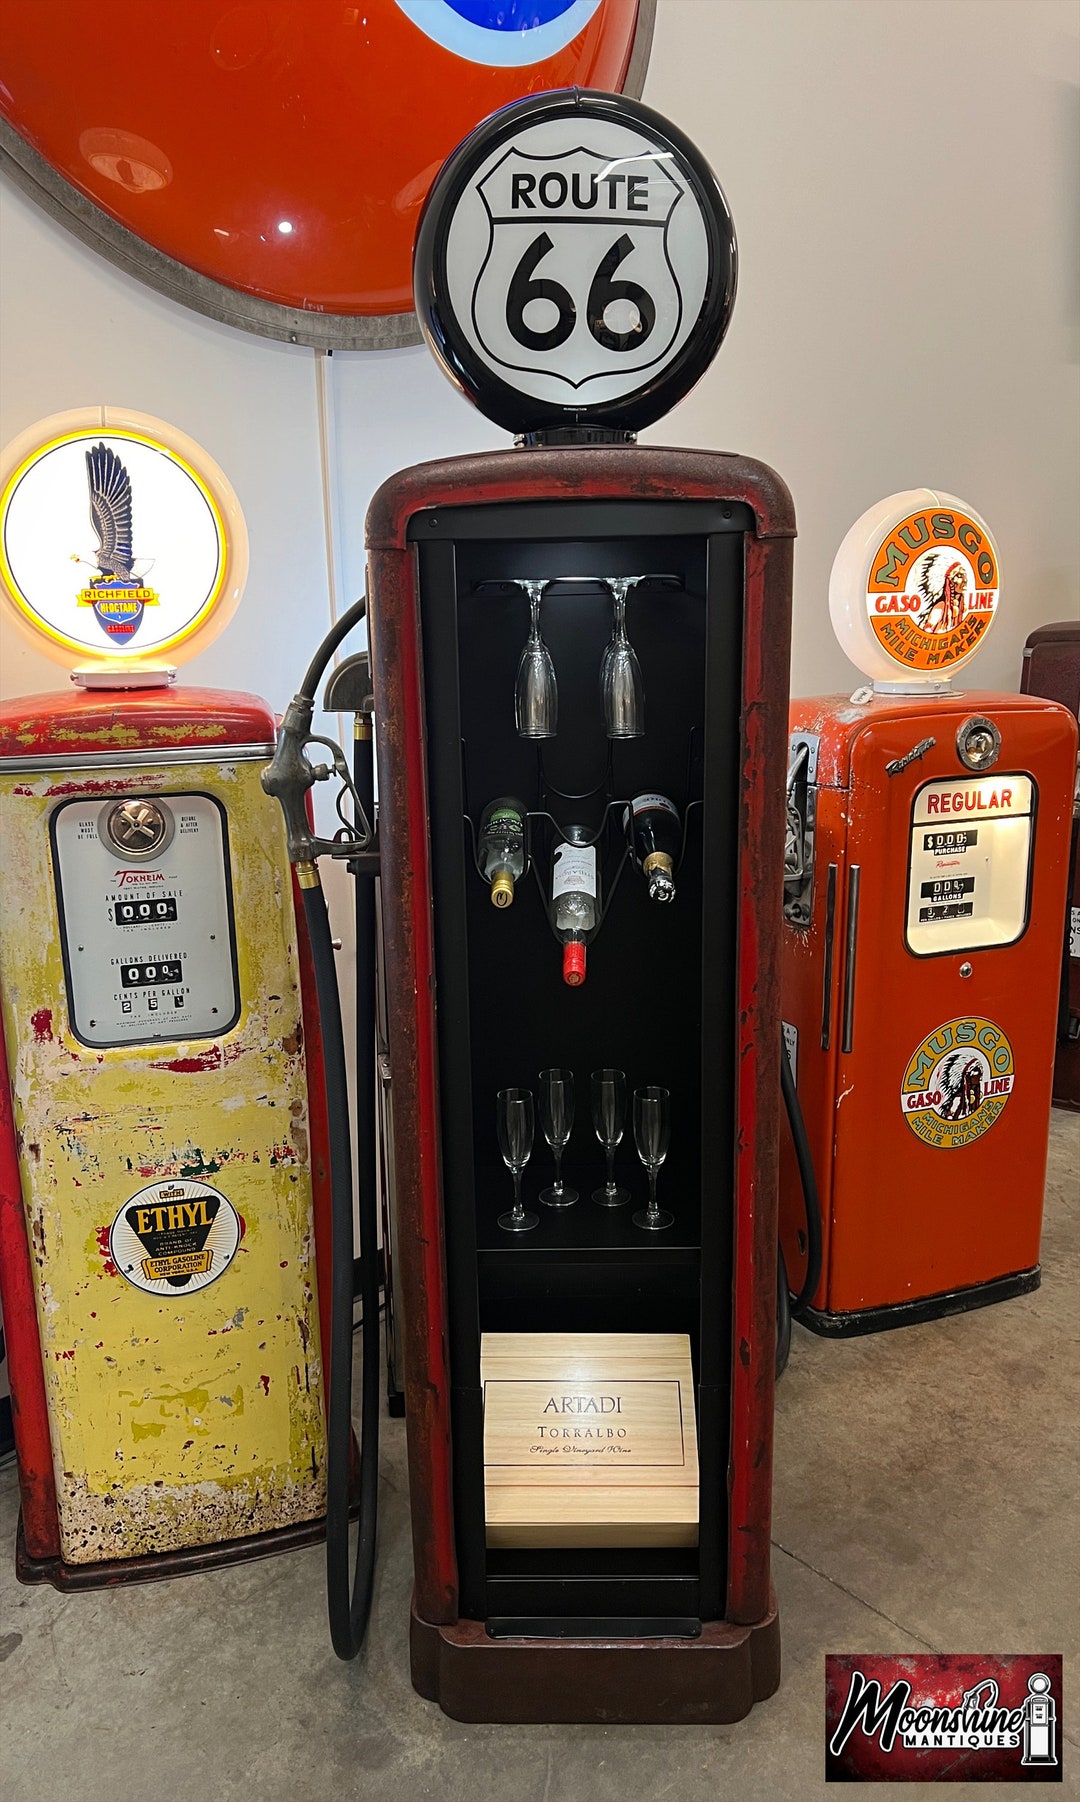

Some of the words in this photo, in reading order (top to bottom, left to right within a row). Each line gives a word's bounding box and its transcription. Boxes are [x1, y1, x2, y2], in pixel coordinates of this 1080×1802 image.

[511, 172, 649, 211] ROUTE
[505, 231, 656, 352] 66
[875, 513, 994, 587] MUSGO
[84, 590, 151, 599] RICHFIELD
[875, 594, 921, 613] GASO
[968, 592, 994, 610] LINE
[895, 615, 977, 651] MICHIGAN'S
[880, 622, 918, 662] MILE
[926, 619, 986, 665] MAKER
[927, 788, 1012, 814] REGULAR
[935, 846, 965, 855] PURCHASE
[105, 892, 140, 901] AMOUNT
[146, 891, 155, 899] OF
[933, 893, 962, 902] GALLONS
[110, 956, 143, 965] GALLONS
[148, 952, 188, 962] DELIVERED
[113, 992, 138, 1000] CENTS
[142, 990, 157, 998] PER
[161, 987, 190, 996] GALLON
[122, 1002, 131, 1011] 2
[150, 999, 157, 1008] 5
[907, 1022, 1011, 1087] MUSGO
[907, 1090, 941, 1109] GASO
[983, 1078, 1010, 1096] LINE
[911, 1116, 943, 1145] MILE
[951, 1101, 1005, 1146] MAKER
[135, 1201, 213, 1234] ETHYL
[158, 1247, 196, 1256] COMPOUND
[150, 1259, 171, 1267] ETHYL
[172, 1253, 205, 1264] GASOLINE
[154, 1261, 202, 1273] CORPORATION
[543, 1396, 622, 1413] ARTADI
[537, 1426, 627, 1438] TORRALBO
[529, 1445, 559, 1455] Single
[562, 1444, 605, 1455] Vineyard
[607, 1445, 632, 1453] Wine
